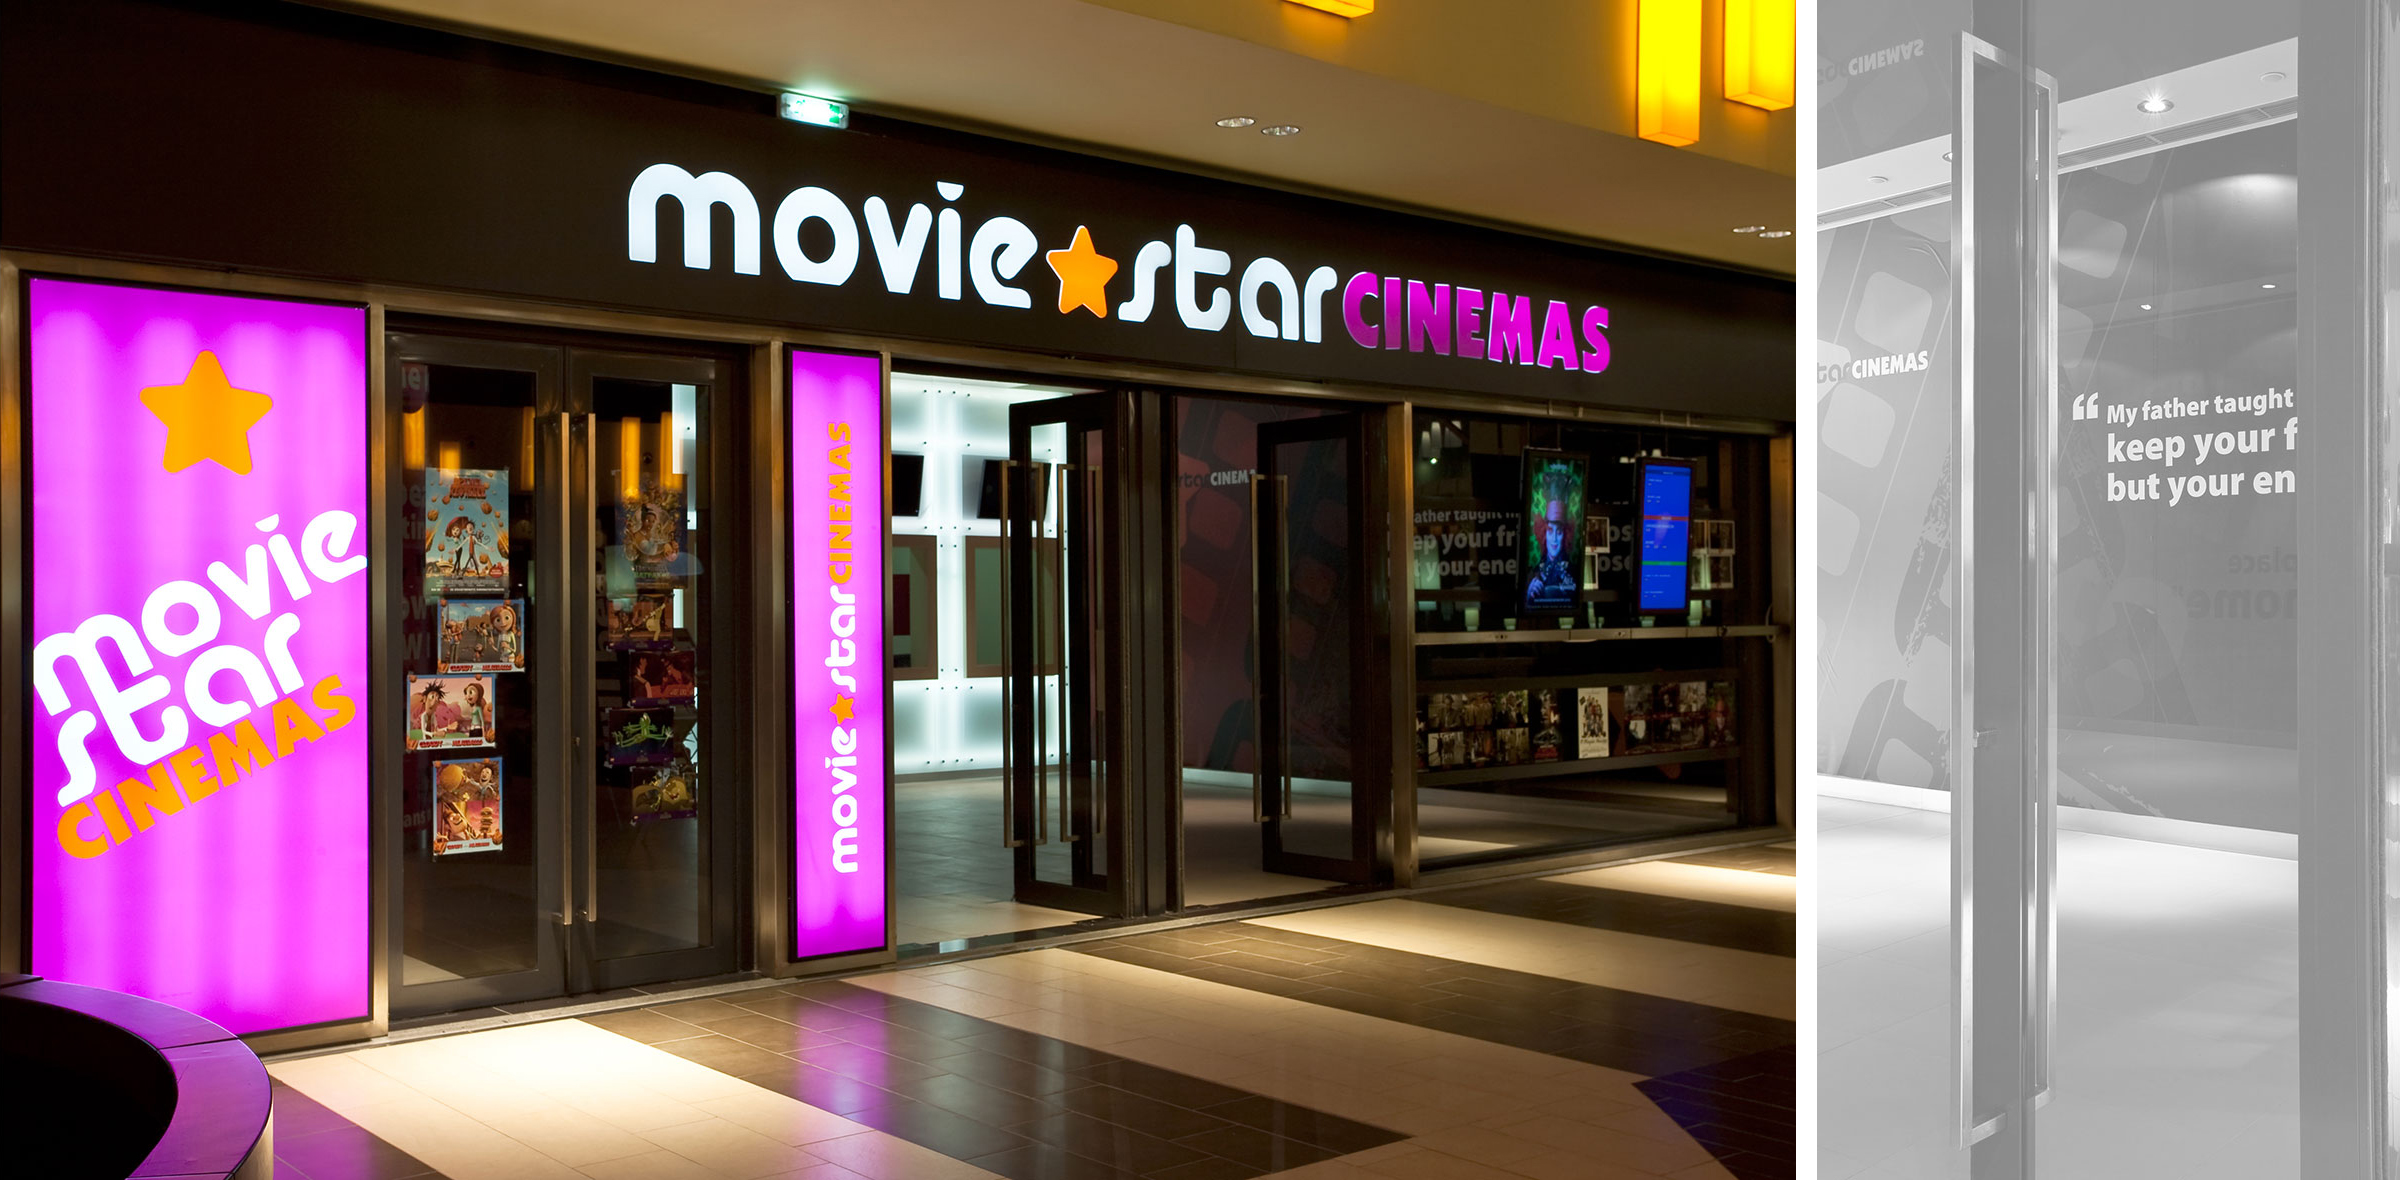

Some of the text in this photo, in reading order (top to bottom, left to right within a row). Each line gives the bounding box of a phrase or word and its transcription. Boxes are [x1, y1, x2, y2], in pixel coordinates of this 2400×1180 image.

[628, 163, 1612, 374] movie star CINEMAS
[1851, 350, 1929, 379] CINEMAS
[2142, 397, 2209, 421] father
[2214, 388, 2294, 416] taught
[2107, 432, 2186, 467] keep
[2193, 428, 2276, 465] your
[1210, 468, 1257, 487] CINEM
[2107, 473, 2160, 502] but
[2167, 473, 2245, 507] your
[1414, 509, 1451, 524] ather
[1441, 529, 1492, 556] your
[1426, 559, 1474, 582] your
[33, 510, 368, 718] movie
[824, 421, 858, 874] movie star CINEMAS
[57, 612, 305, 808] star
[56, 673, 357, 860] CINEMAS
